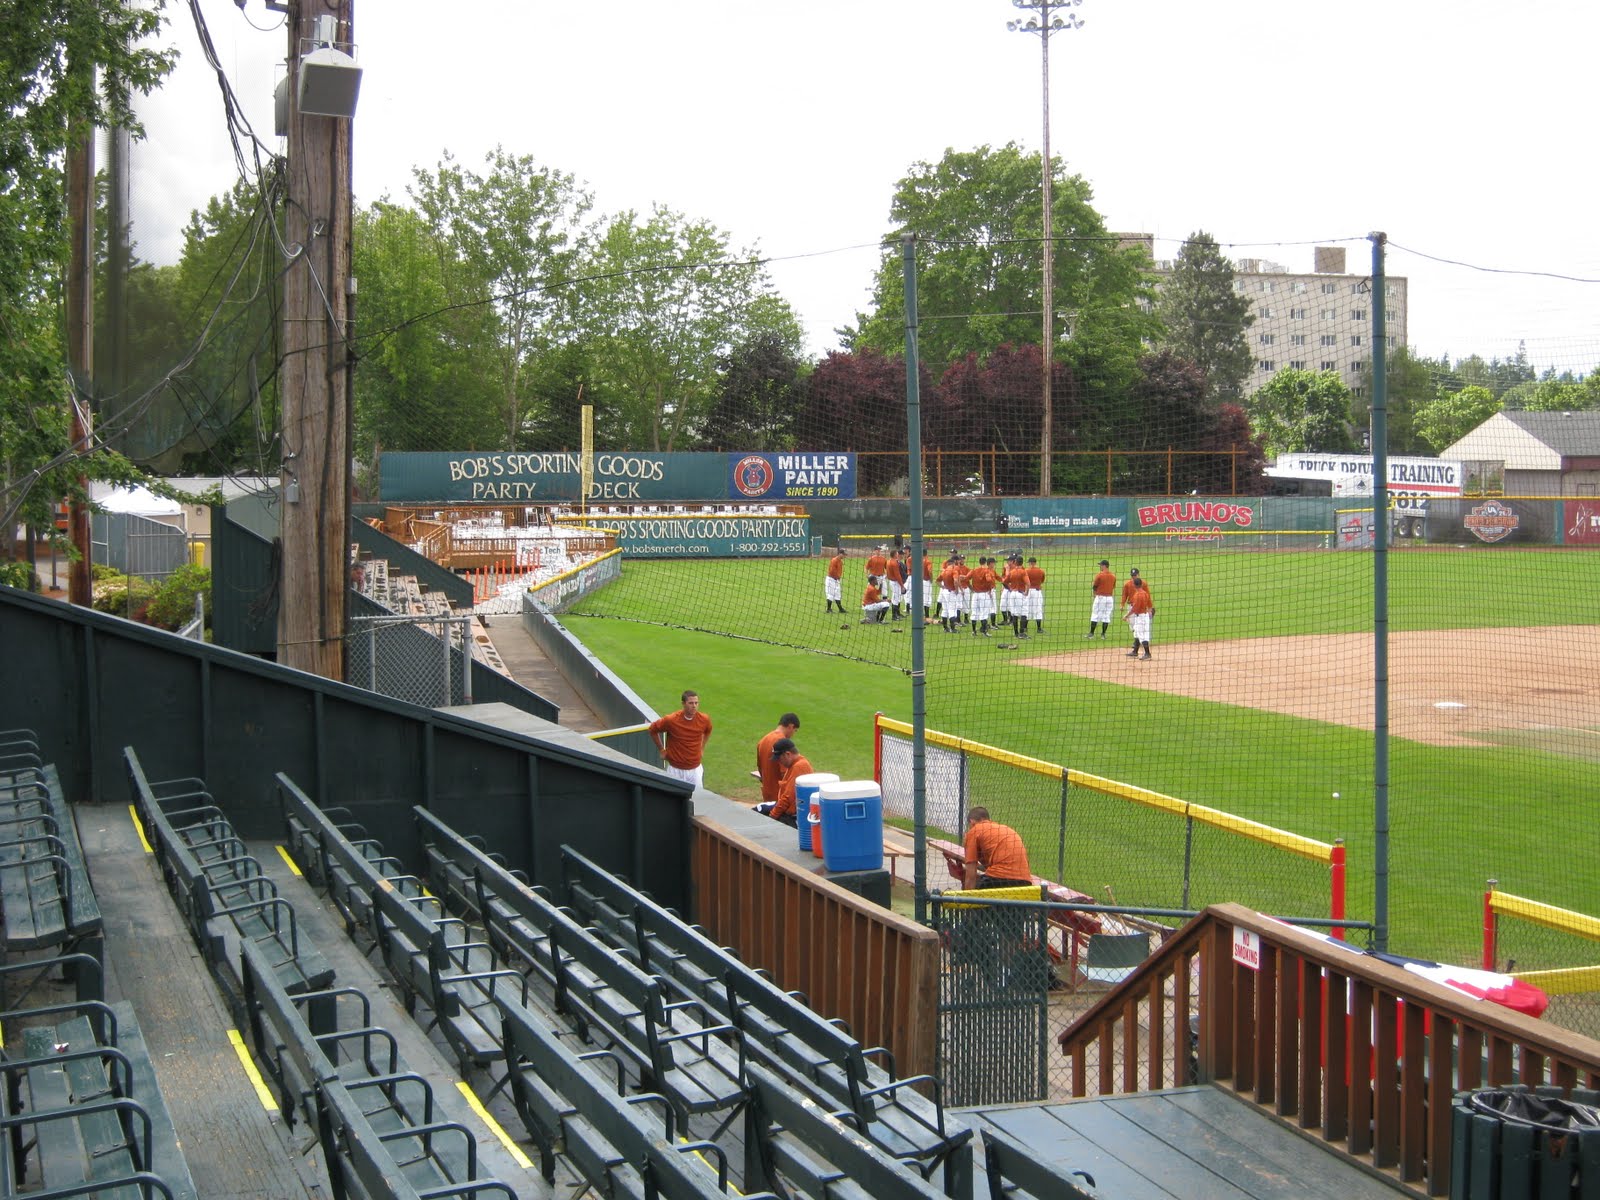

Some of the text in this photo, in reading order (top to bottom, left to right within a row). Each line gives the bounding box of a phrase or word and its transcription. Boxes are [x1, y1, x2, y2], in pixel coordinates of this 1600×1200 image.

[449, 453, 664, 481] BOB'S SPORTIN GOODS
[779, 455, 848, 470] MILLER
[785, 470, 843, 485] PAINT
[1391, 464, 1455, 484] TRAINING
[472, 482, 641, 499] PARTY DECK
[816, 487, 839, 497] 1890
[1137, 501, 1254, 527] BRUNO'S
[639, 519, 695, 539] SPORTING
[697, 519, 739, 538] GOODS
[741, 519, 775, 539] PARTY
[776, 519, 806, 538] DECK
[1032, 516, 1070, 528] Banking
[1072, 516, 1099, 526] made
[1101, 517, 1122, 528] easy
[1165, 526, 1225, 541] PIZZA
[545, 546, 560, 554] Tech
[730, 543, 806, 552] 1-800-292-5551
[1243, 930, 1249, 946] NO
[1235, 943, 1257, 964] SMOKING
